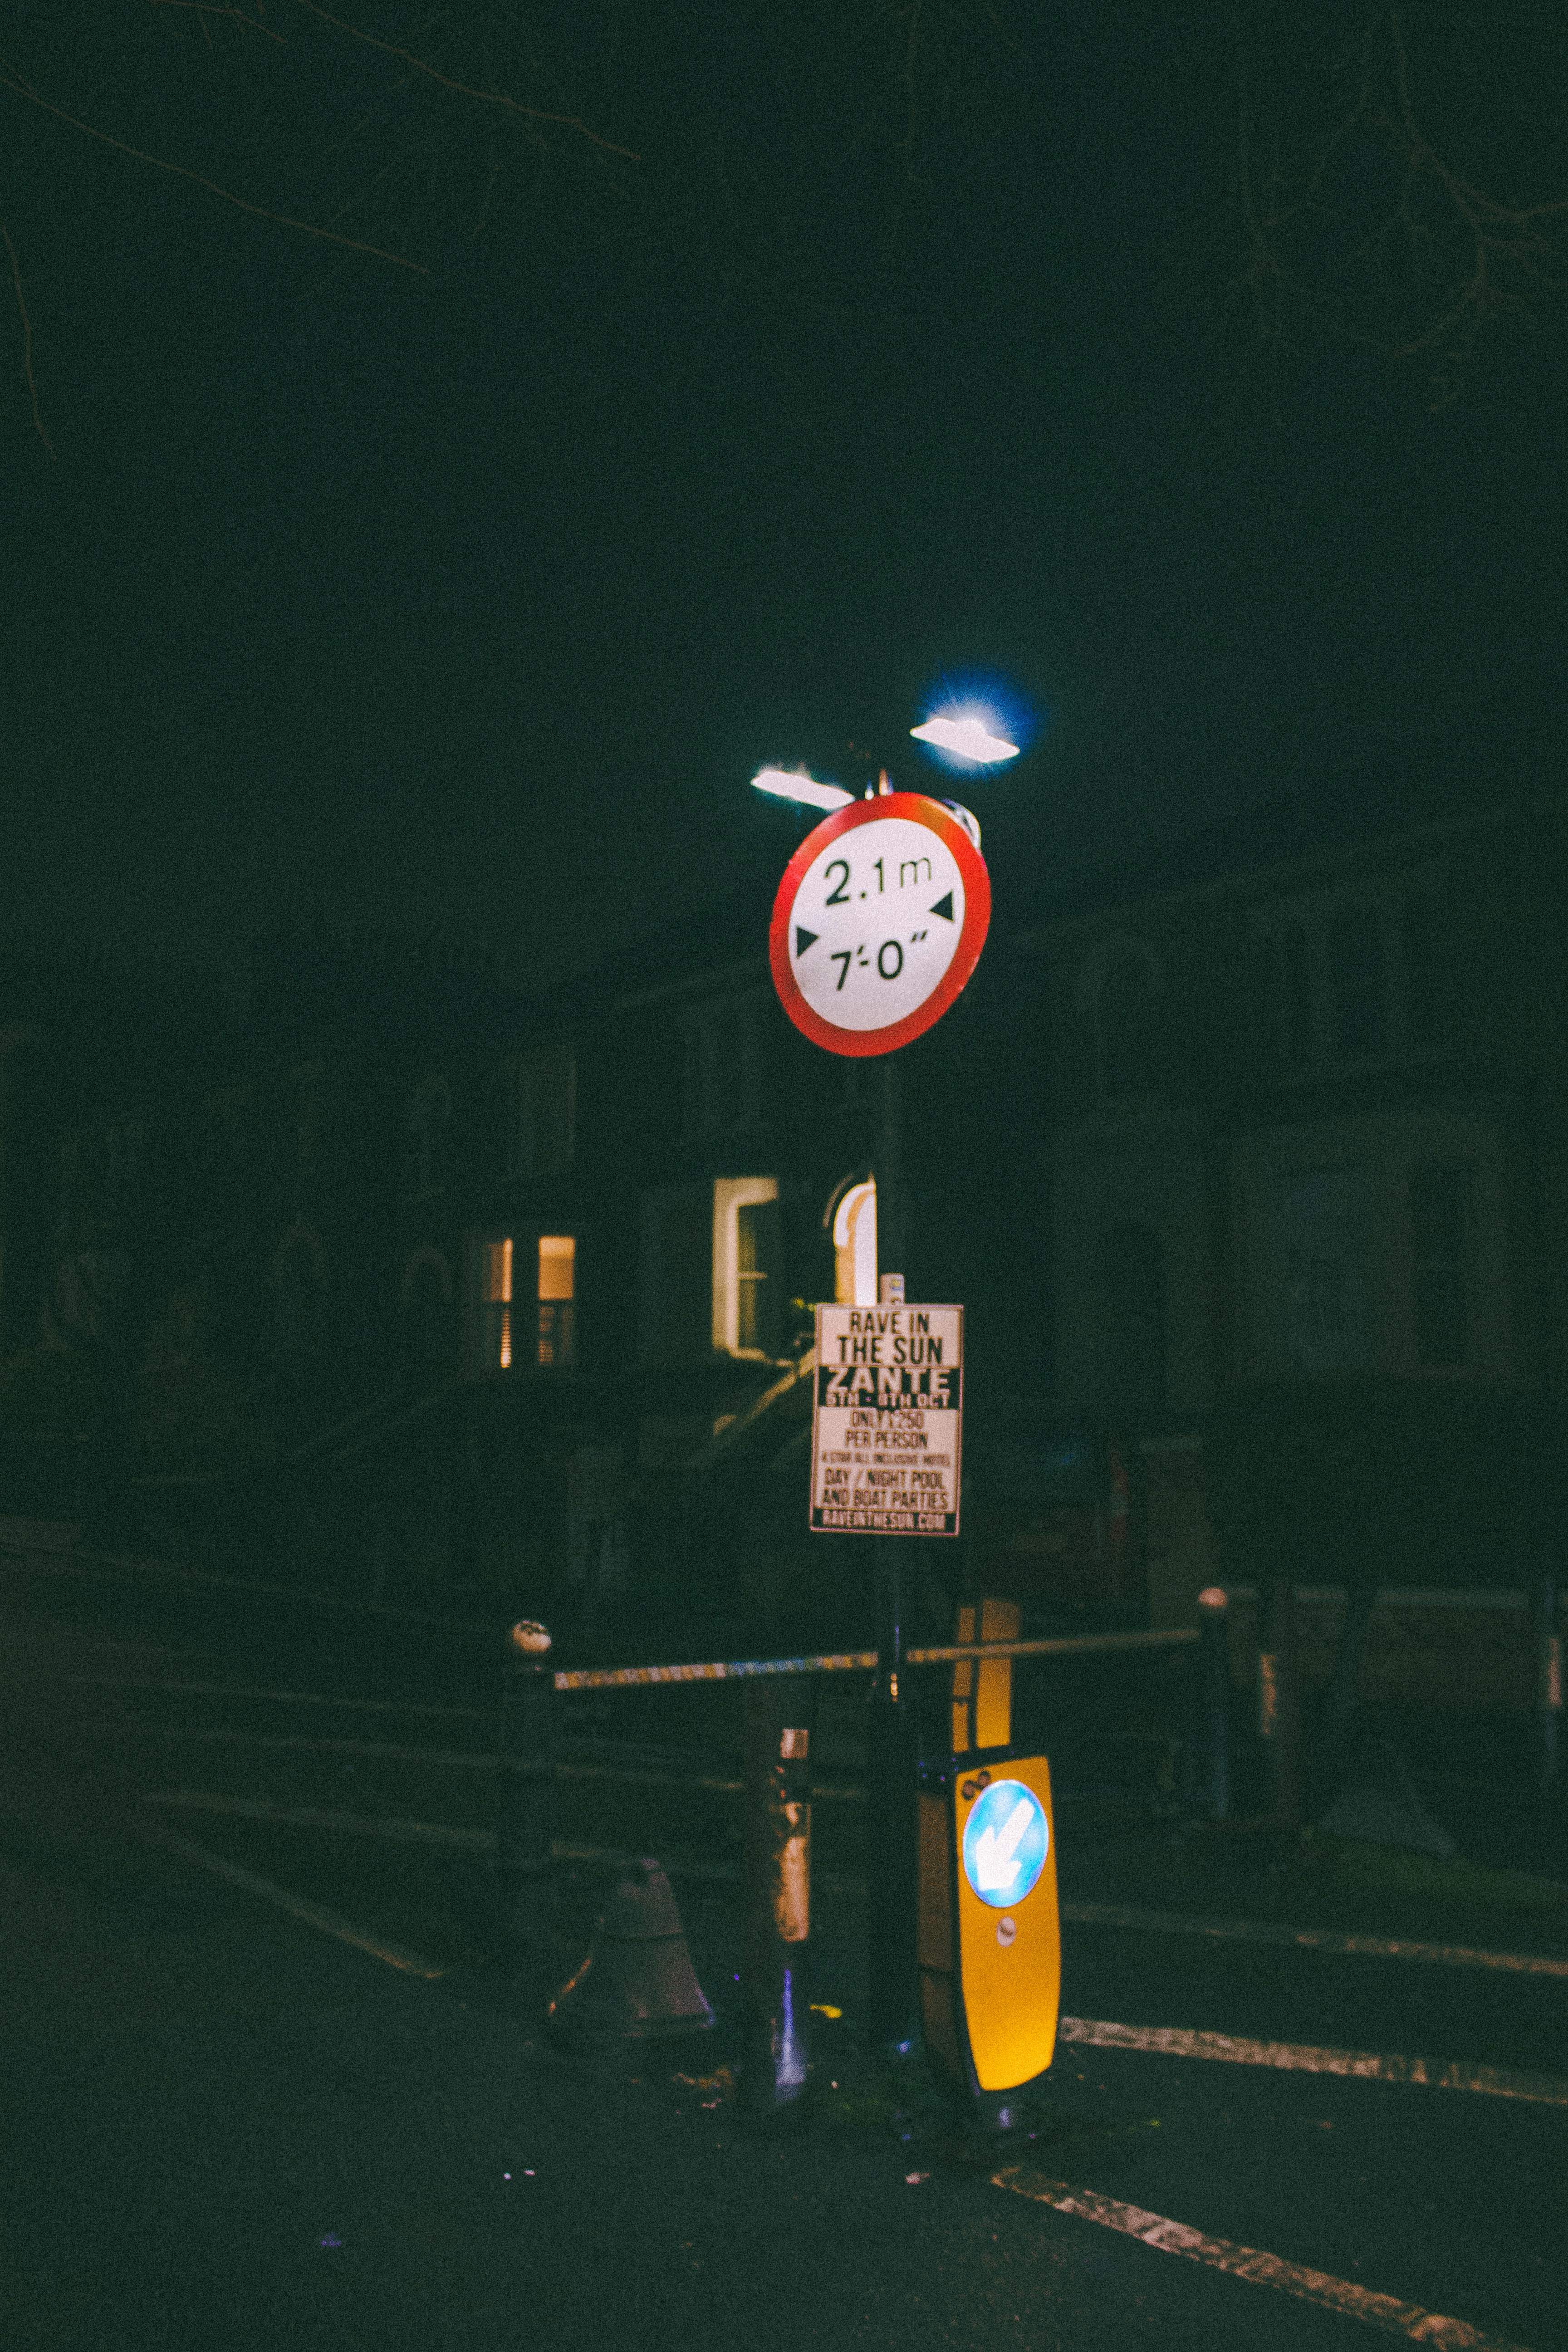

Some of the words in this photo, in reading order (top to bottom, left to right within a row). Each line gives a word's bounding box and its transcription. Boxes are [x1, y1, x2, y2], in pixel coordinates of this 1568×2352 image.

[850, 1312, 901, 1334] RAVE
[909, 1312, 929, 1335] IN
[837, 1335, 883, 1363] THE
[893, 1336, 943, 1365] SUN
[826, 1367, 951, 1394] ZANTE
[917, 1393, 949, 1407] OCT
[846, 1430, 871, 1448] PER
[875, 1431, 928, 1449] PERSON
[825, 1467, 851, 1485] DAY
[911, 1470, 945, 1490] POOL
[821, 1488, 849, 1507] AND
[853, 1489, 888, 1507] BOAT
[892, 1490, 949, 1510] PARTIES
